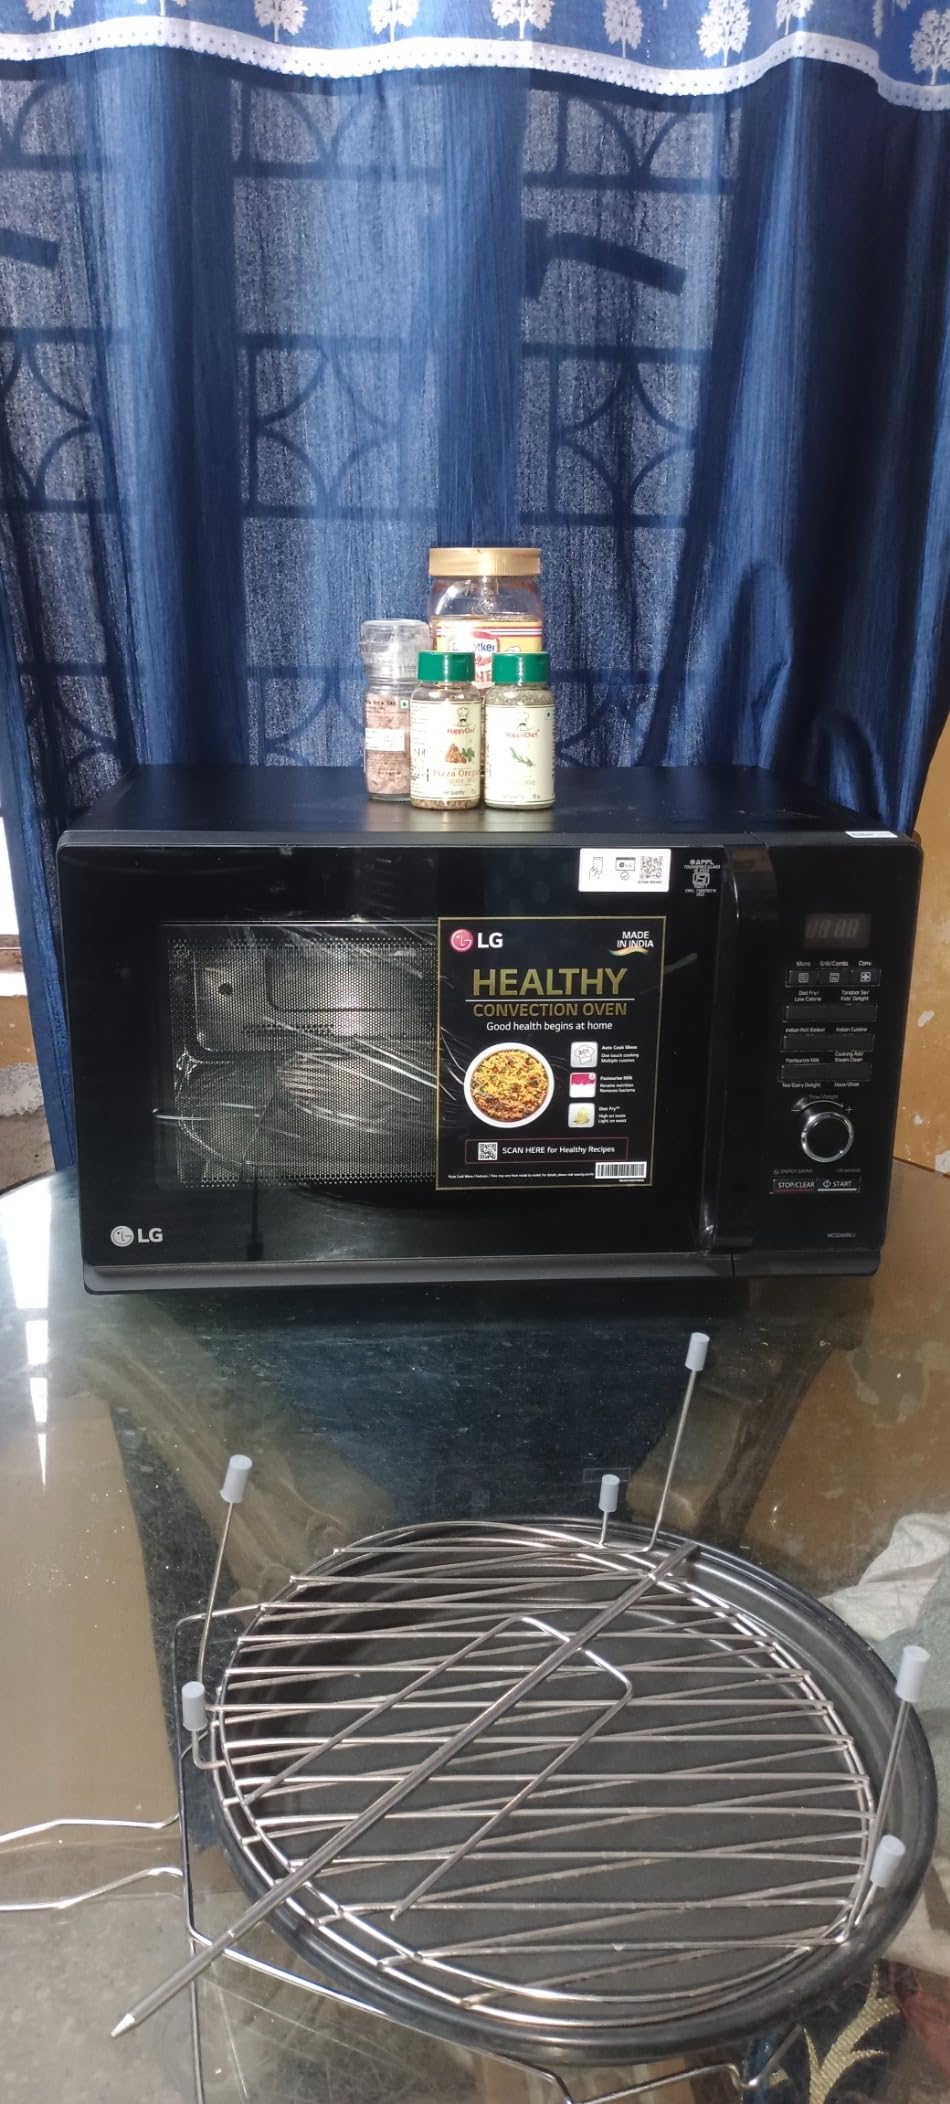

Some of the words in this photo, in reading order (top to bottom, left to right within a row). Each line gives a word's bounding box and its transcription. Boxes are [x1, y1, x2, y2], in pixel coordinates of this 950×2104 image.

[477, 932, 504, 949] LG
[622, 931, 650, 940] MADE
[617, 940, 627, 949] IN
[628, 939, 654, 949] INDIA
[473, 967, 629, 996] HEALTHY
[473, 1003, 578, 1017] CONVECTION
[582, 1002, 628, 1016] OVEN
[486, 1021, 512, 1031] Good
[513, 1021, 542, 1031] health
[544, 1020, 574, 1033] begins
[576, 1021, 585, 1030] at
[587, 1020, 613, 1030] home
[525, 1146, 545, 1154] HERE
[559, 1146, 587, 1155] Healthy
[588, 1145, 615, 1154] Recipes
[778, 1181, 815, 1189] STOP/CLEAR
[833, 1180, 853, 1188] START
[137, 1227, 164, 1243] LG
